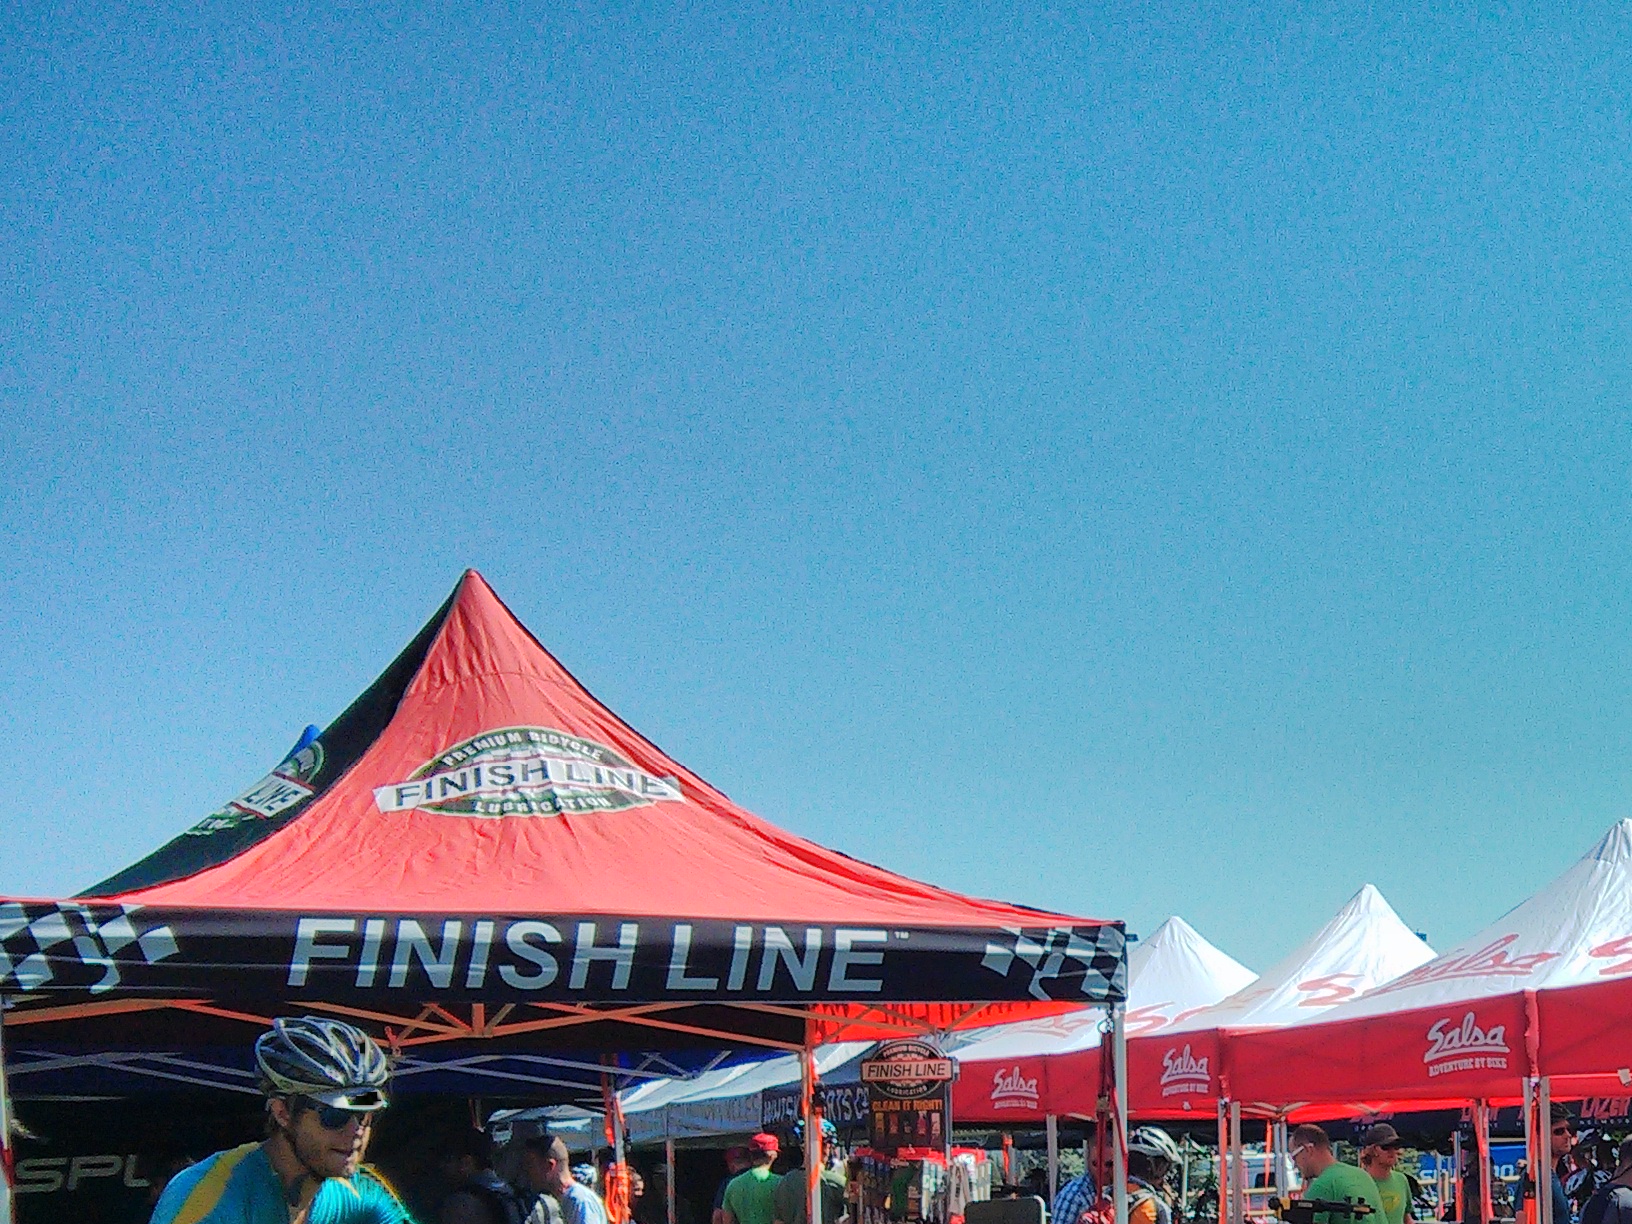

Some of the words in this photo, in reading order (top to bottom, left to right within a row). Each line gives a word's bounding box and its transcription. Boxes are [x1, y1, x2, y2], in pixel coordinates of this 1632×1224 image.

[442, 731, 522, 766] PREMIUM
[395, 760, 549, 807] FINISH
[566, 763, 669, 797] LINE
[473, 797, 611, 814] LUBRICATION
[287, 918, 640, 990] FINISH
[665, 924, 889, 993] LINE
[1423, 1011, 1511, 1064] Salsa
[867, 1064, 912, 1078] FINISH
[915, 1062, 946, 1076] LINE
[990, 1066, 1040, 1099] Salsa
[1160, 1043, 1211, 1085] Salsa
